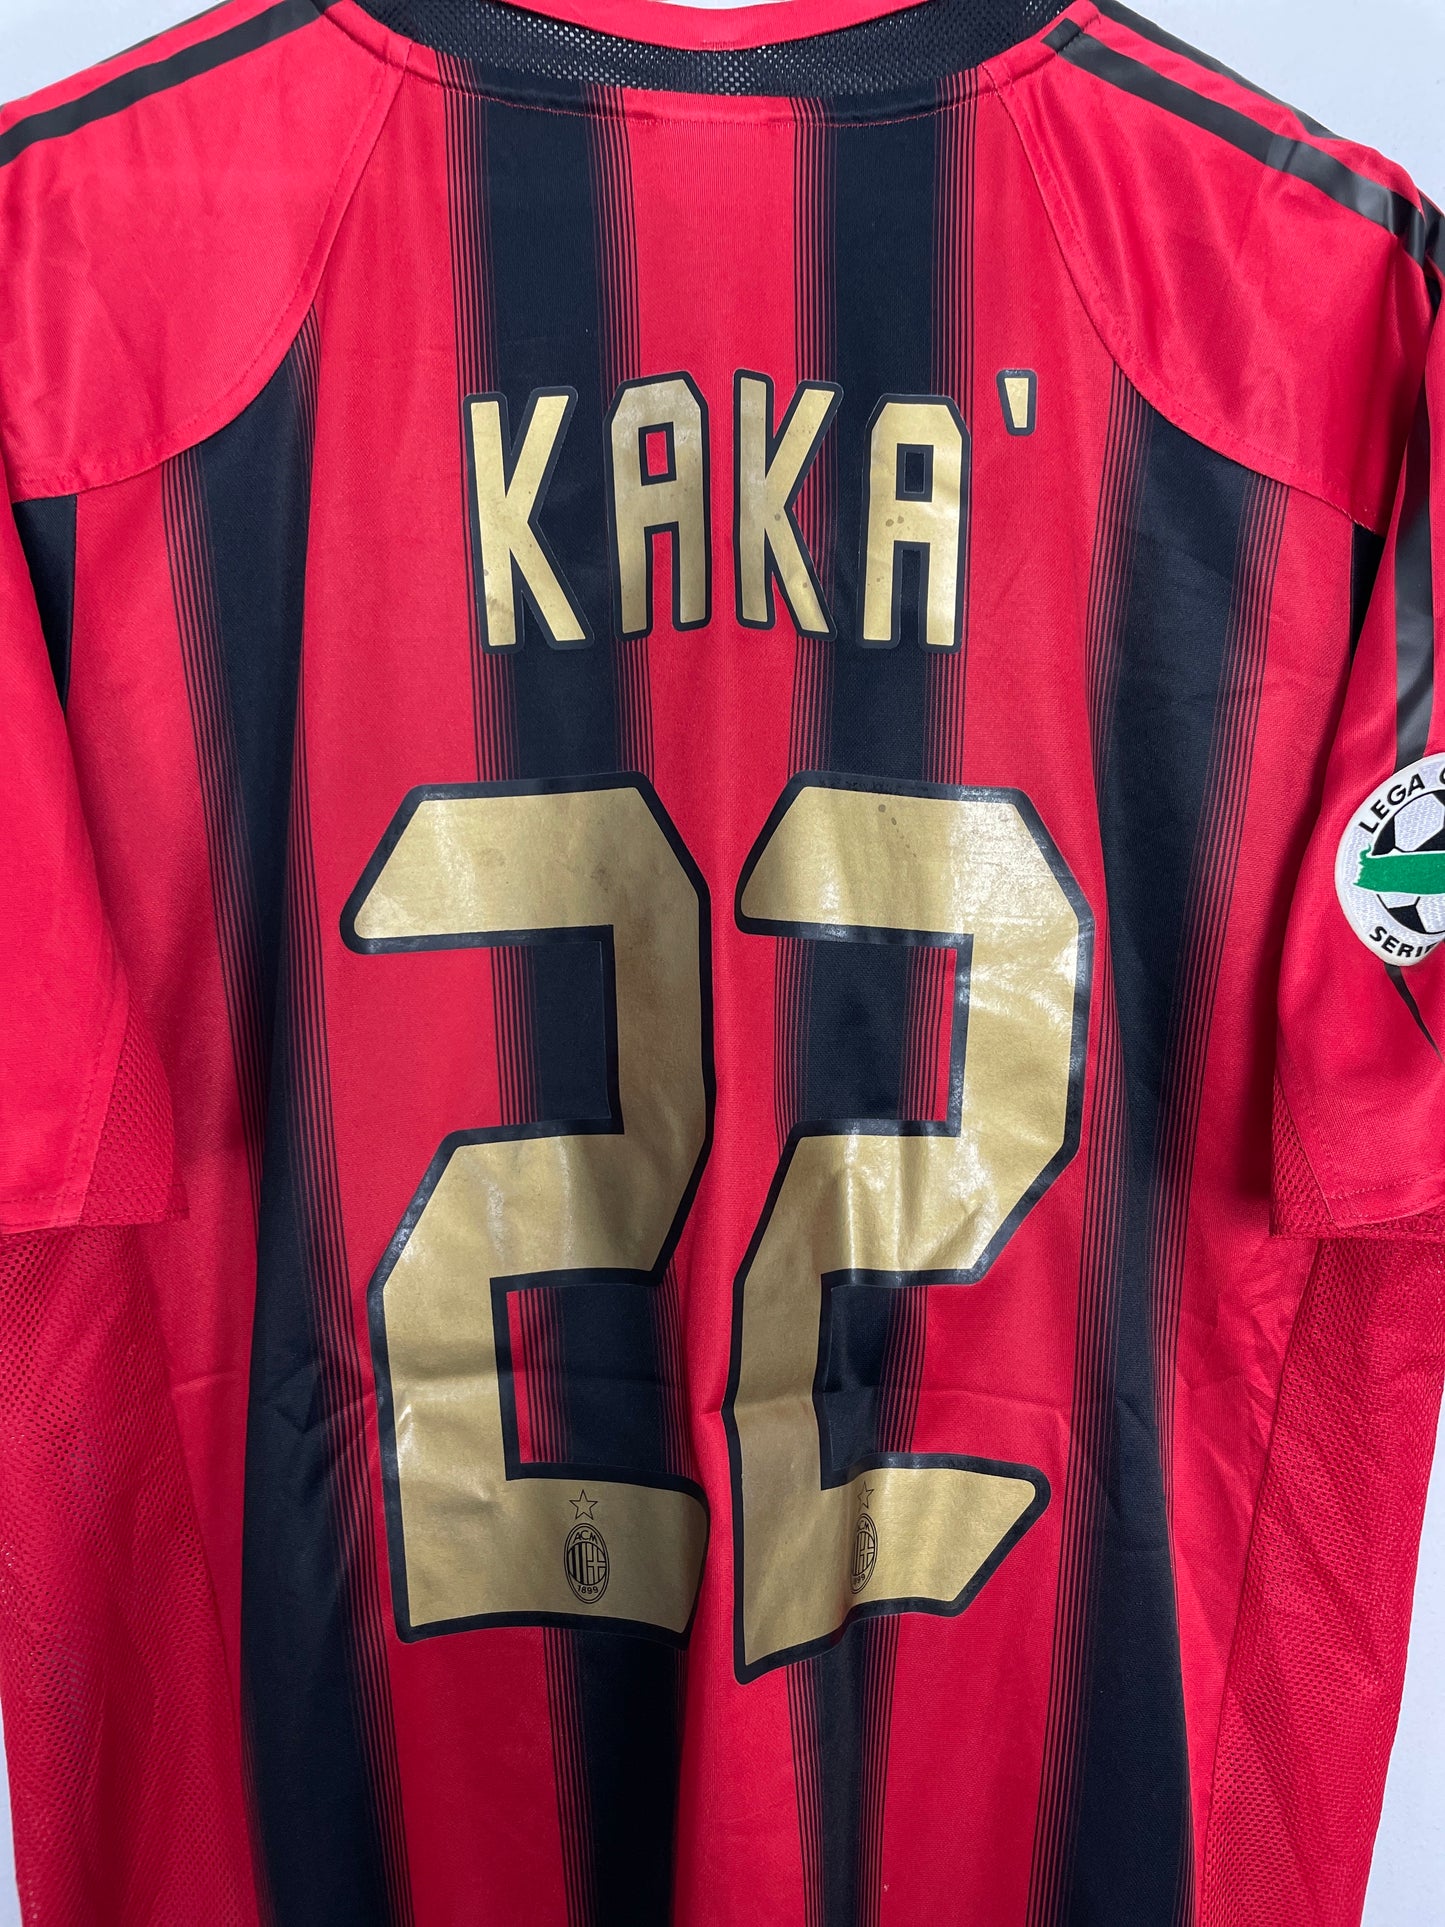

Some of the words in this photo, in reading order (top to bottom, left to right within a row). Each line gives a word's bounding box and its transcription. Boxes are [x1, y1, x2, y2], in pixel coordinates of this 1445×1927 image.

[463, 369, 1037, 654] KAKA'
[1358, 773, 1426, 834] LEGA
[340, 770, 1093, 1684] 22
[573, 1530, 597, 1544] ACM
[577, 1584, 599, 1595] 1899
